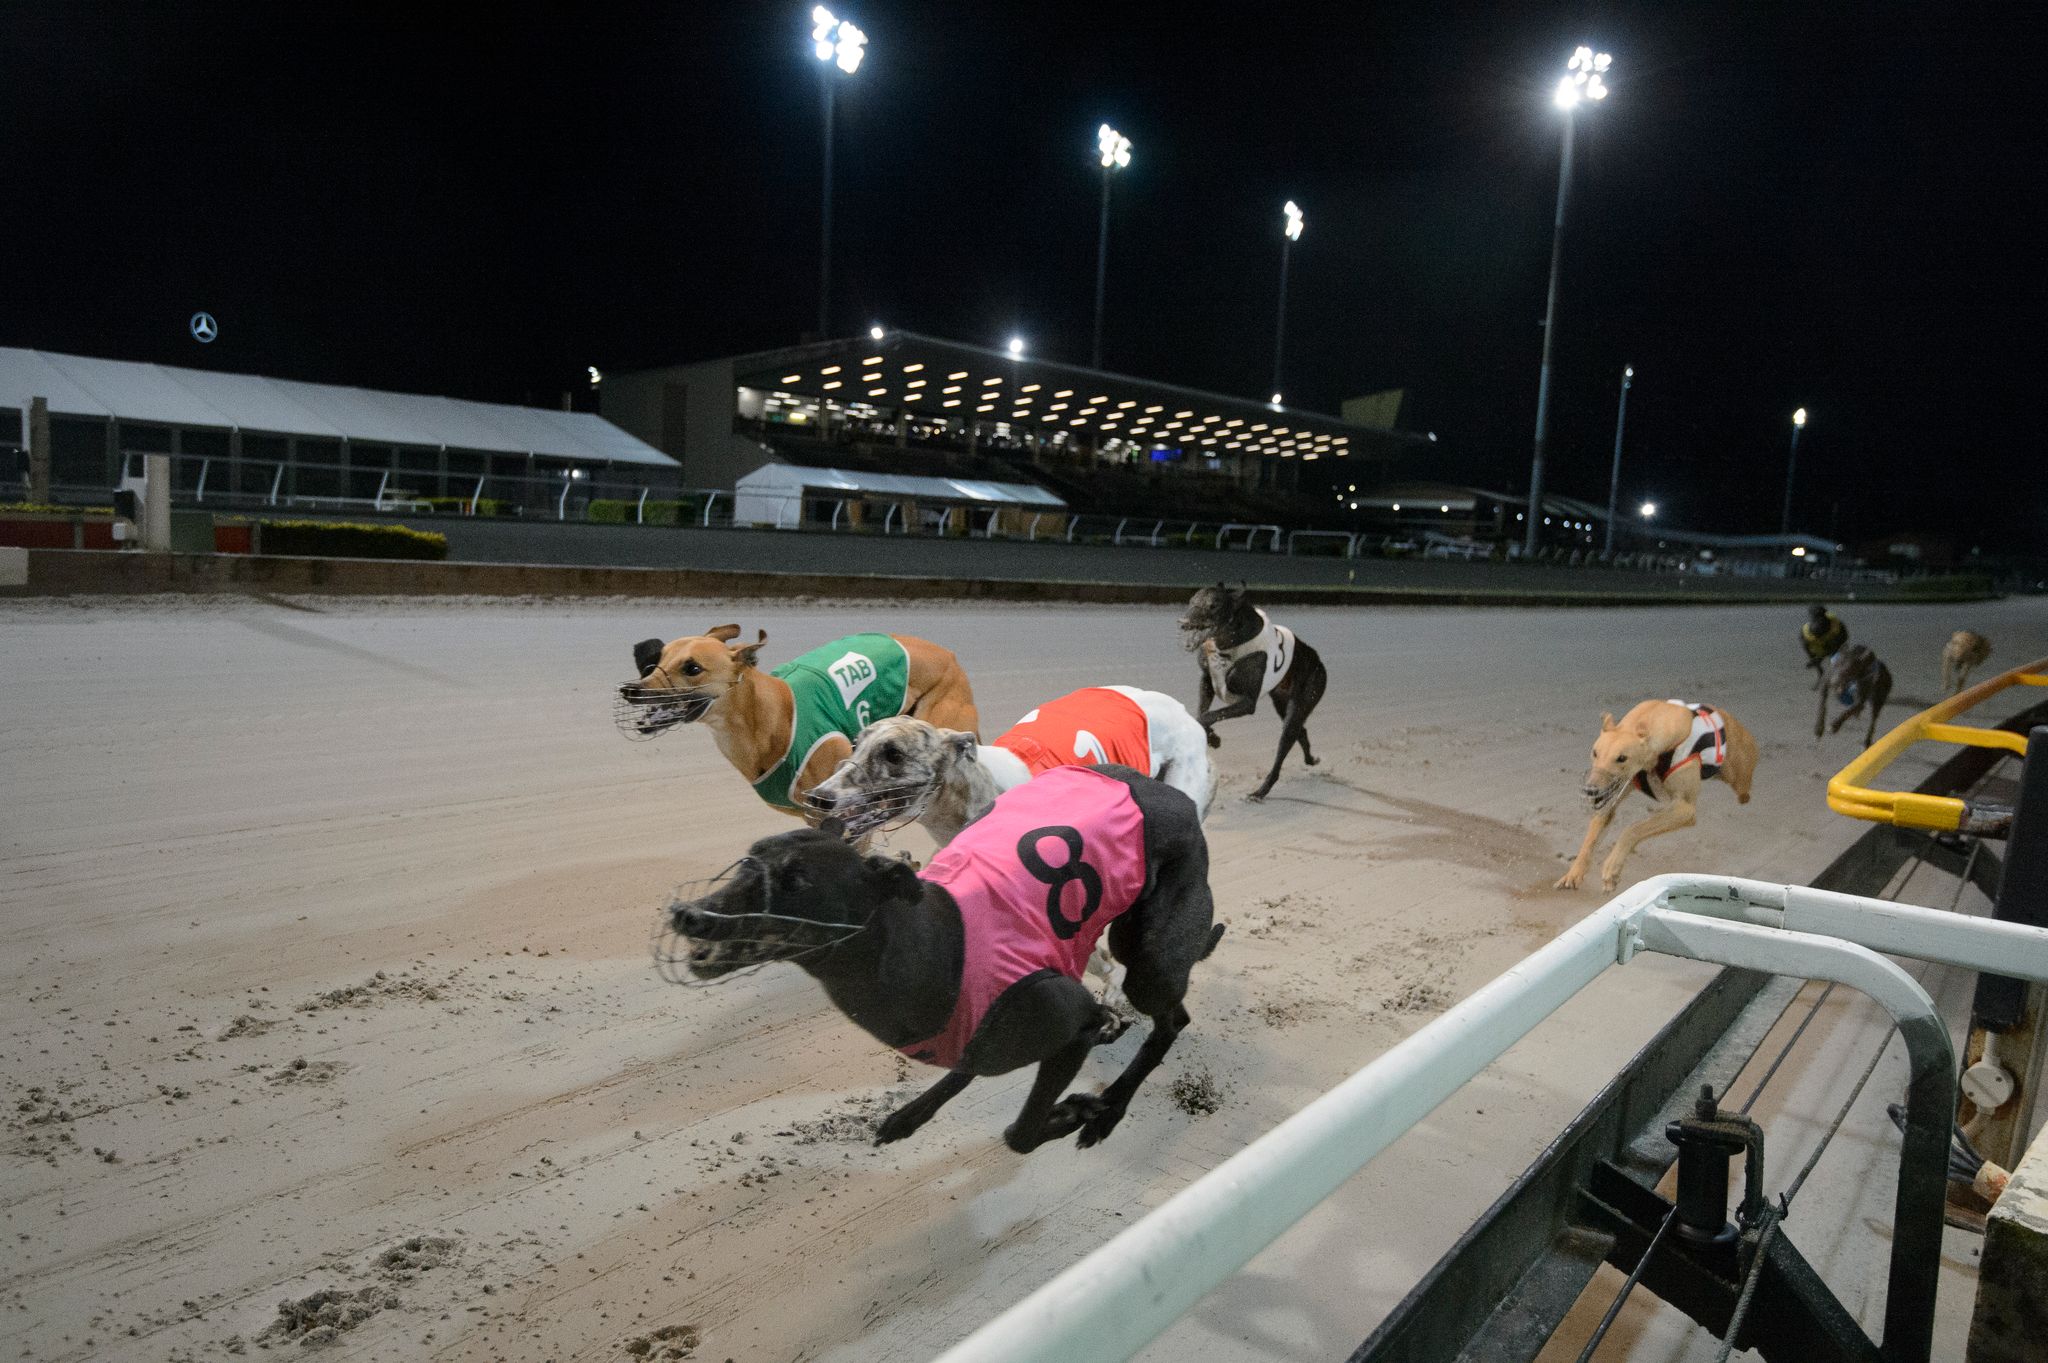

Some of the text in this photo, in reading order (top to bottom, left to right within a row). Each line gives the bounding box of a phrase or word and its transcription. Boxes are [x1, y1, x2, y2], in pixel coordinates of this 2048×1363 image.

[1274, 626, 1286, 673] 3
[834, 659, 872, 688] TAB
[856, 700, 871, 731] 6
[1016, 825, 1103, 940] 8
